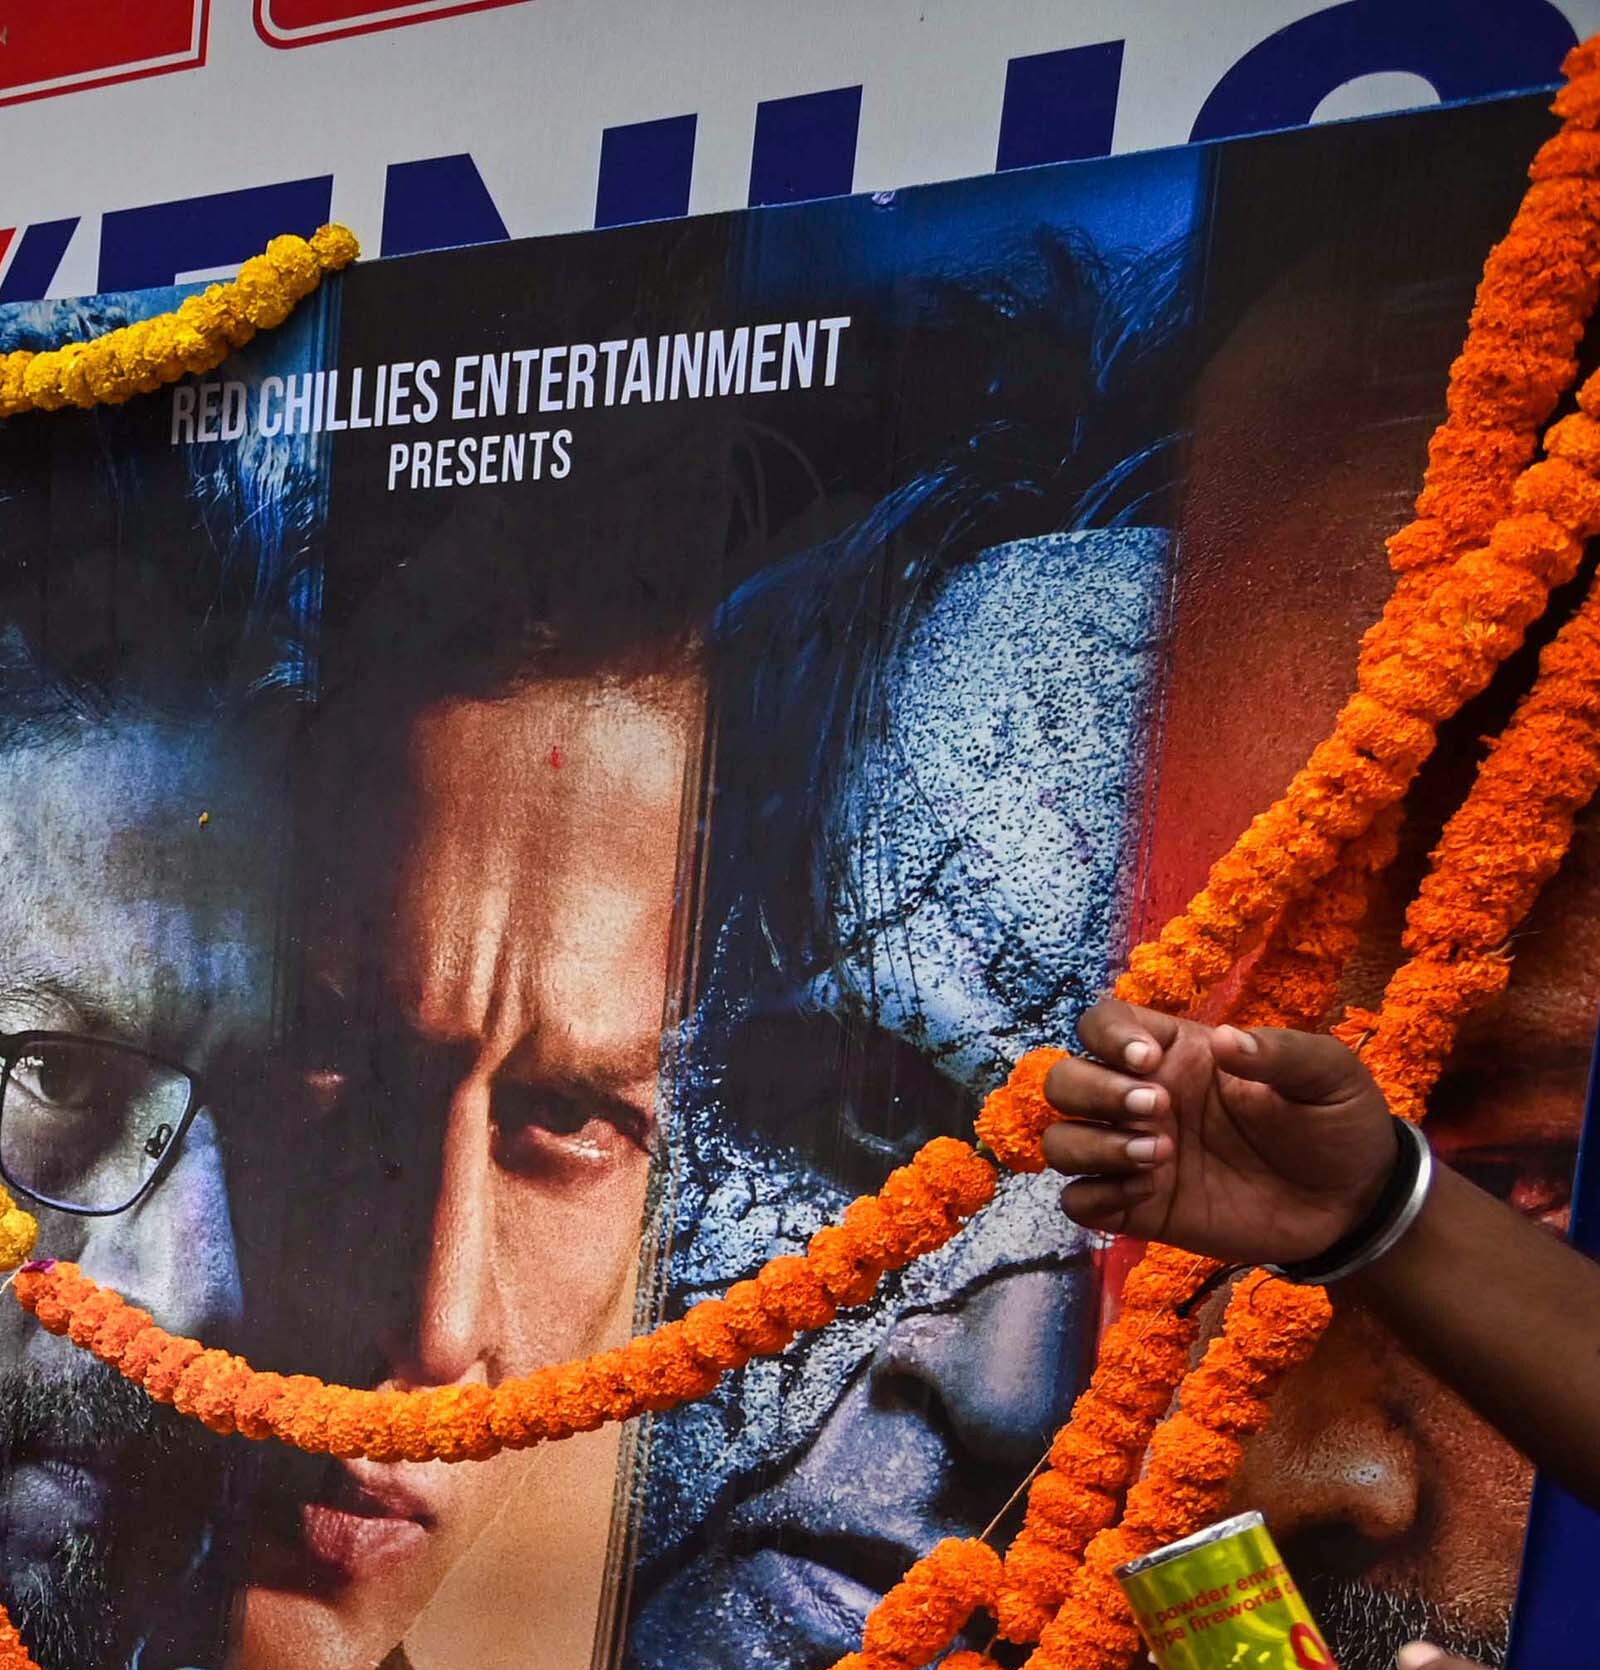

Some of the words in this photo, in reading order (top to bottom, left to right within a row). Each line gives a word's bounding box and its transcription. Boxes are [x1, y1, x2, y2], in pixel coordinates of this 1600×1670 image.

[170, 379, 247, 445] RED
[258, 358, 441, 439] CHILLIES
[451, 316, 851, 421] ENTERTAINMENT
[387, 429, 573, 490] PRESENTS
[1189, 1585, 1283, 1632] fireworks
